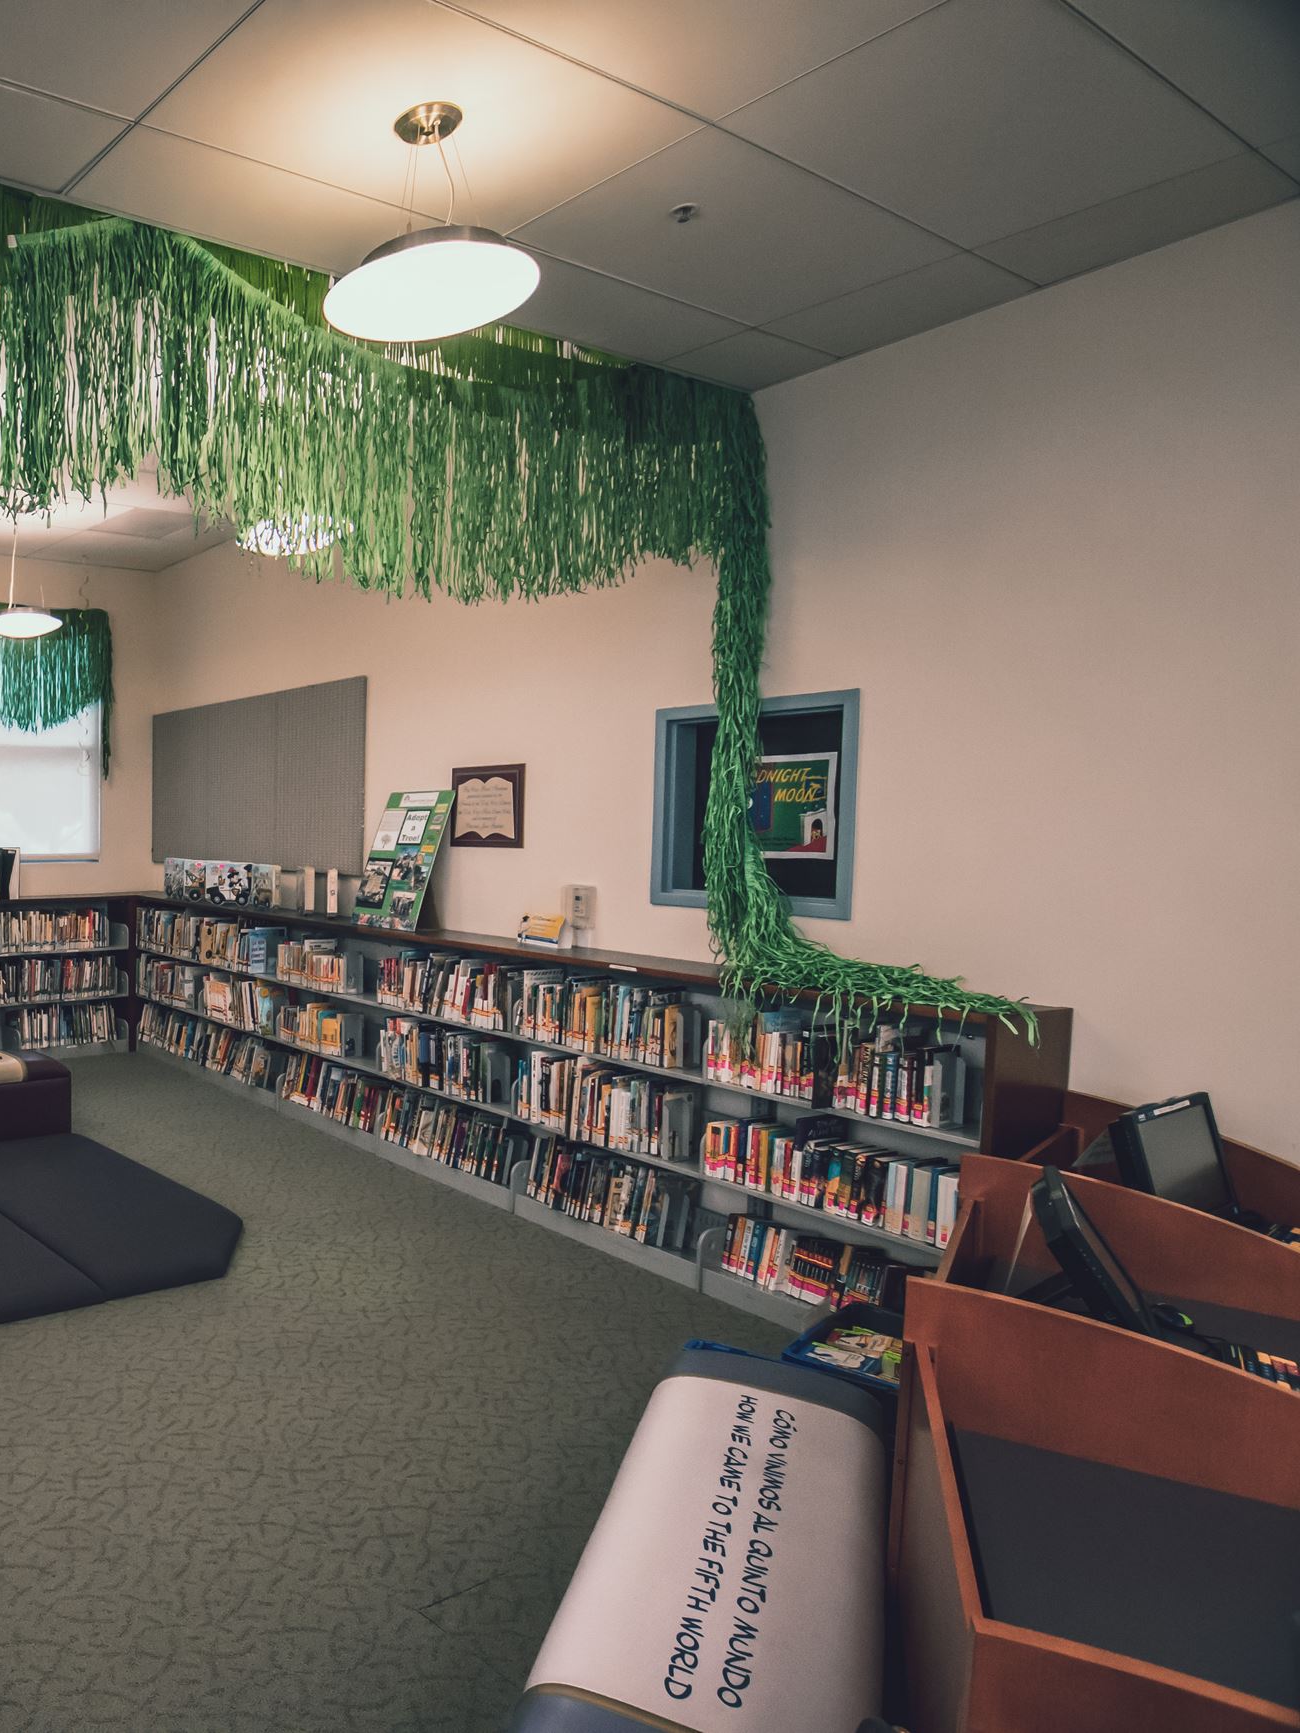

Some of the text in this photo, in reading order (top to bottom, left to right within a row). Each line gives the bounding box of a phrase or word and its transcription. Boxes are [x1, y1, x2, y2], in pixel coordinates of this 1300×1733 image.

[756, 768, 812, 785] DNIGHT
[774, 784, 821, 803] MOON
[406, 813, 428, 822] Adopt
[664, 1394, 758, 1700] HOW WE CAME TO THE FIFTH WORLD
[717, 1409, 796, 1709] CÓMO VINIMOS AL QUINTO MUNDO
